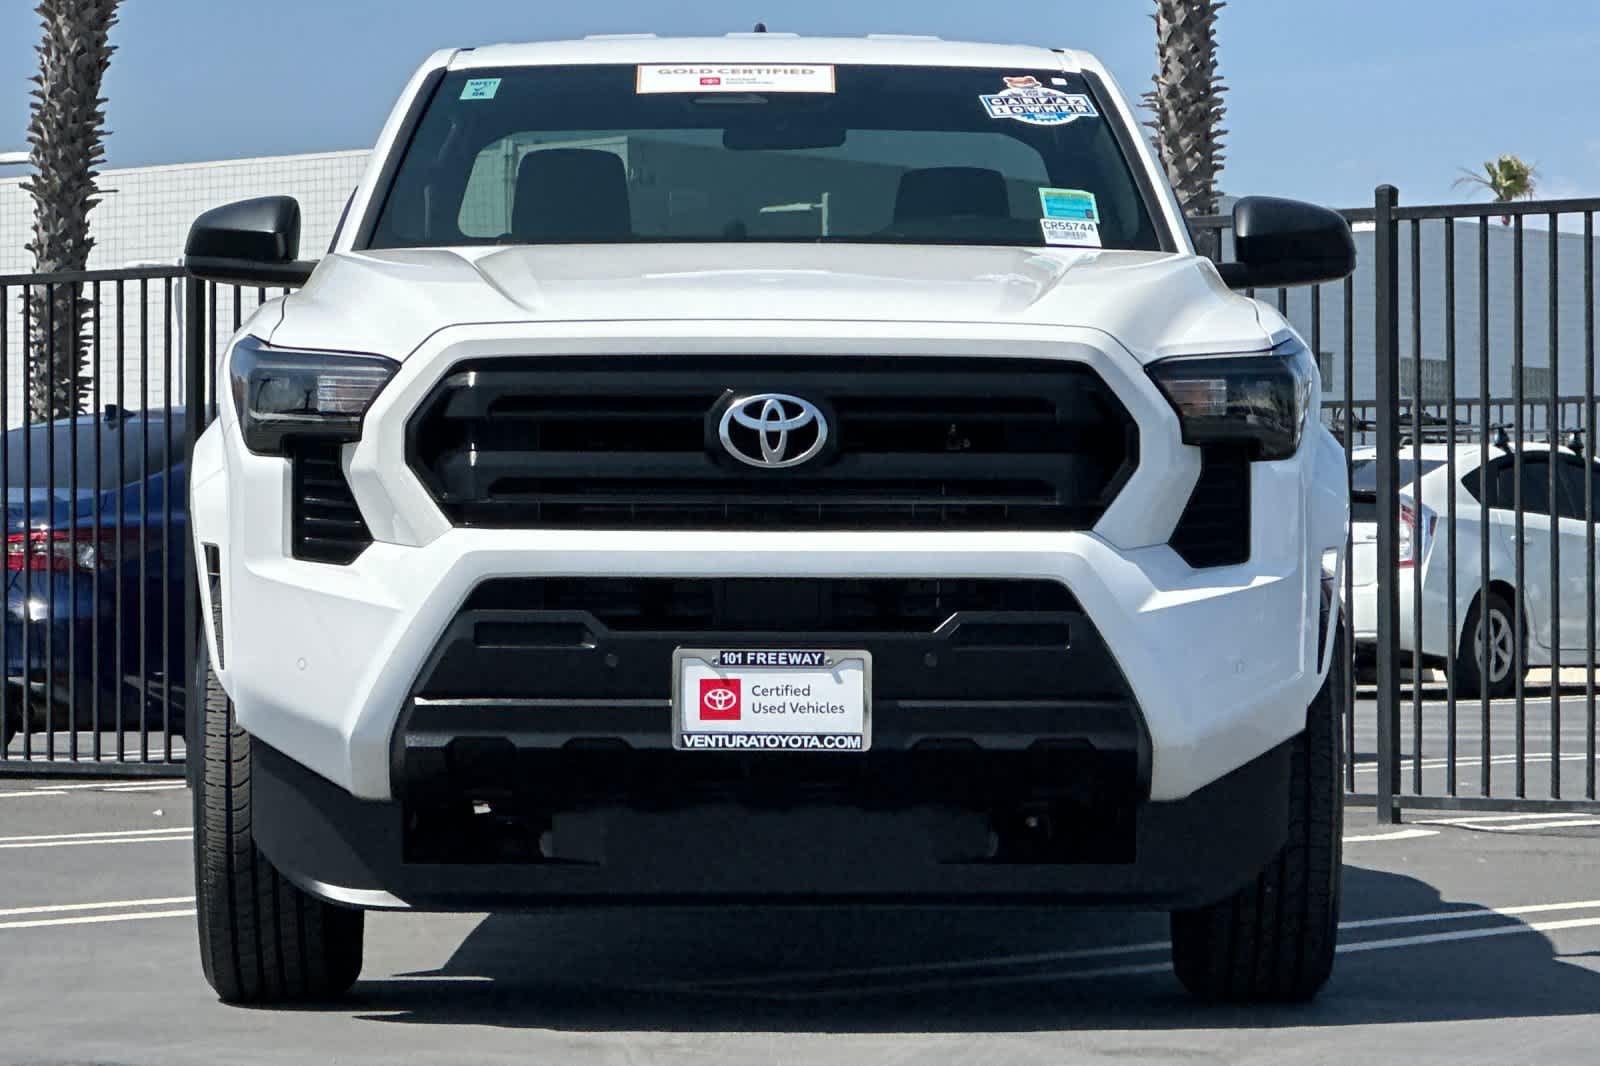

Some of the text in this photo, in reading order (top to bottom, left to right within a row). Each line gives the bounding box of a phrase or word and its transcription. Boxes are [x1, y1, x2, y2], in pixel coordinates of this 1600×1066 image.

[1012, 105, 1088, 113] OWNER
[1043, 221, 1094, 231] CR55744
[722, 653, 822, 665] 101 FREEWAY
[752, 685, 811, 697] Certified
[752, 702, 845, 714] Used Vehicles
[683, 735, 861, 748] VENTURATOYOTA.COM
